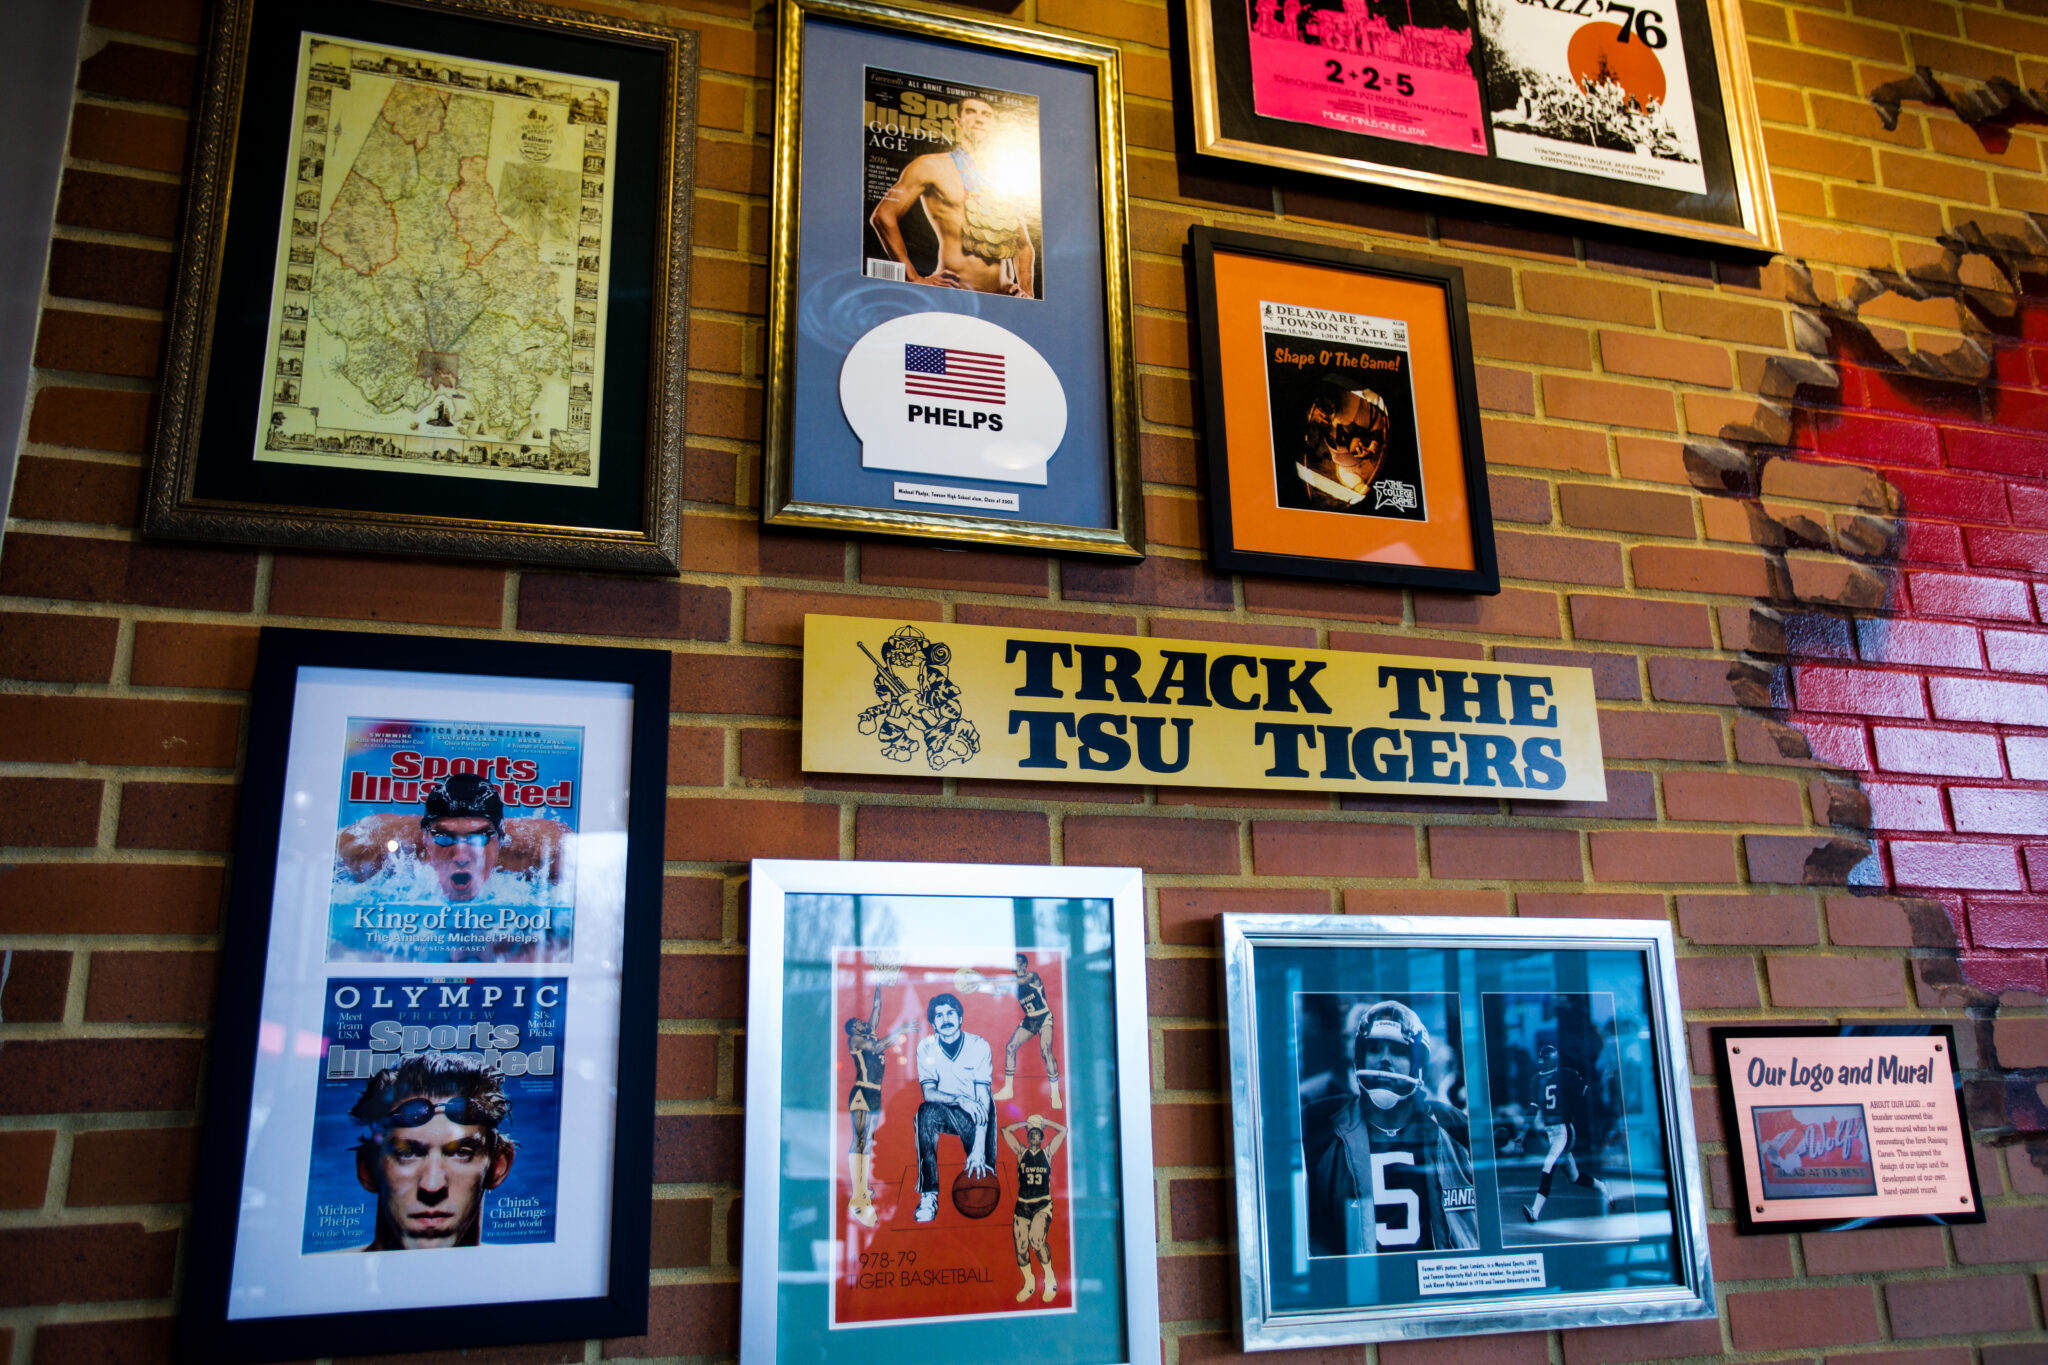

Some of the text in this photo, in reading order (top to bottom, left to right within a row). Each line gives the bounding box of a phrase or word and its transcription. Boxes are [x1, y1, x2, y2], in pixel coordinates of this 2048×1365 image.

[1326, 60, 1344, 83] 2
[1363, 67, 1380, 90] 2
[1396, 74, 1414, 96] 5
[869, 120, 953, 146] GOLDEN
[868, 134, 908, 152] AGE
[1276, 306, 1358, 324] DELAWARE
[1278, 316, 1338, 332] TOWSON
[1344, 326, 1388, 340] STATE
[1274, 347, 1401, 372] Shape O' The Game!
[908, 404, 1004, 432] PHELPS
[1004, 638, 1560, 728] TRACK THE
[390, 726, 452, 735] OLYMPICS
[490, 729, 541, 738] BEIJING
[1006, 708, 1569, 792] TSU TIGERS
[390, 750, 540, 781] Sports
[354, 906, 552, 932] King of the Pool
[366, 932, 538, 945] The Amazing Michael Phelps
[334, 986, 558, 1009] OLYMPIC
[339, 1012, 362, 1020] Meet
[398, 1012, 495, 1020] PREVIEW
[534, 1010, 550, 1019] SI's
[336, 1022, 363, 1030] Team
[528, 1020, 555, 1028] Medal
[338, 1031, 360, 1040] USA
[369, 1020, 520, 1053] Sports
[529, 1028, 552, 1038] Picks
[1748, 1055, 1934, 1092] Our Logo and Mural
[1545, 1084, 1558, 1110] 5
[1870, 1100, 1890, 1108] ABOUT
[1891, 1100, 1904, 1108] OUR
[1894, 1112, 1922, 1120] uncovered
[1896, 1124, 1912, 1132] mural
[1906, 1136, 1915, 1145] the
[1896, 1149, 1910, 1157] This
[1932, 1148, 1942, 1156] the
[1929, 1161, 1940, 1169] and
[1026, 1174, 1043, 1185] 33
[1882, 1174, 1917, 1184] development
[498, 1196, 540, 1208] China's
[1370, 1151, 1420, 1246] 5
[318, 1204, 365, 1216] Michael
[490, 1208, 546, 1220] Challenge
[320, 1216, 360, 1228] Phelps
[492, 1219, 543, 1229] To the World
[326, 1229, 340, 1238] the
[848, 1268, 993, 1289] TIGER BASKETBALL
